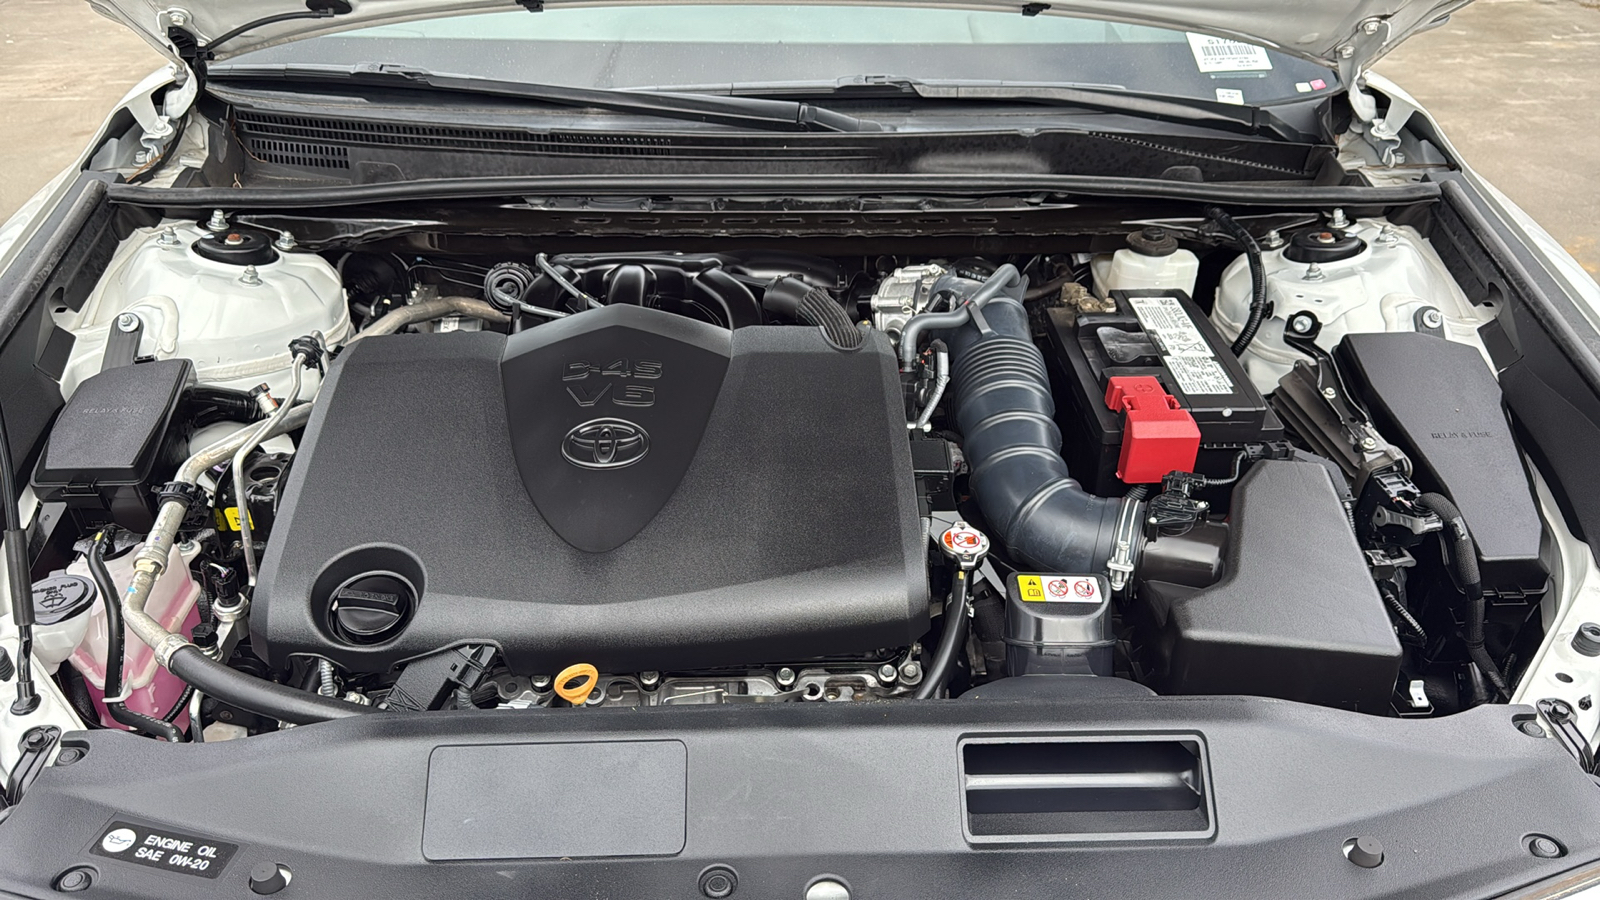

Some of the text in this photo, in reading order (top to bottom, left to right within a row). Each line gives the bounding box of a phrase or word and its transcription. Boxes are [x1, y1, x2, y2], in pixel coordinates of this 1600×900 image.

[562, 358, 662, 381] D-4S
[566, 383, 656, 407] V6
[144, 834, 217, 858] ENGINE OIL
[135, 847, 210, 870] SAE 0W-20
